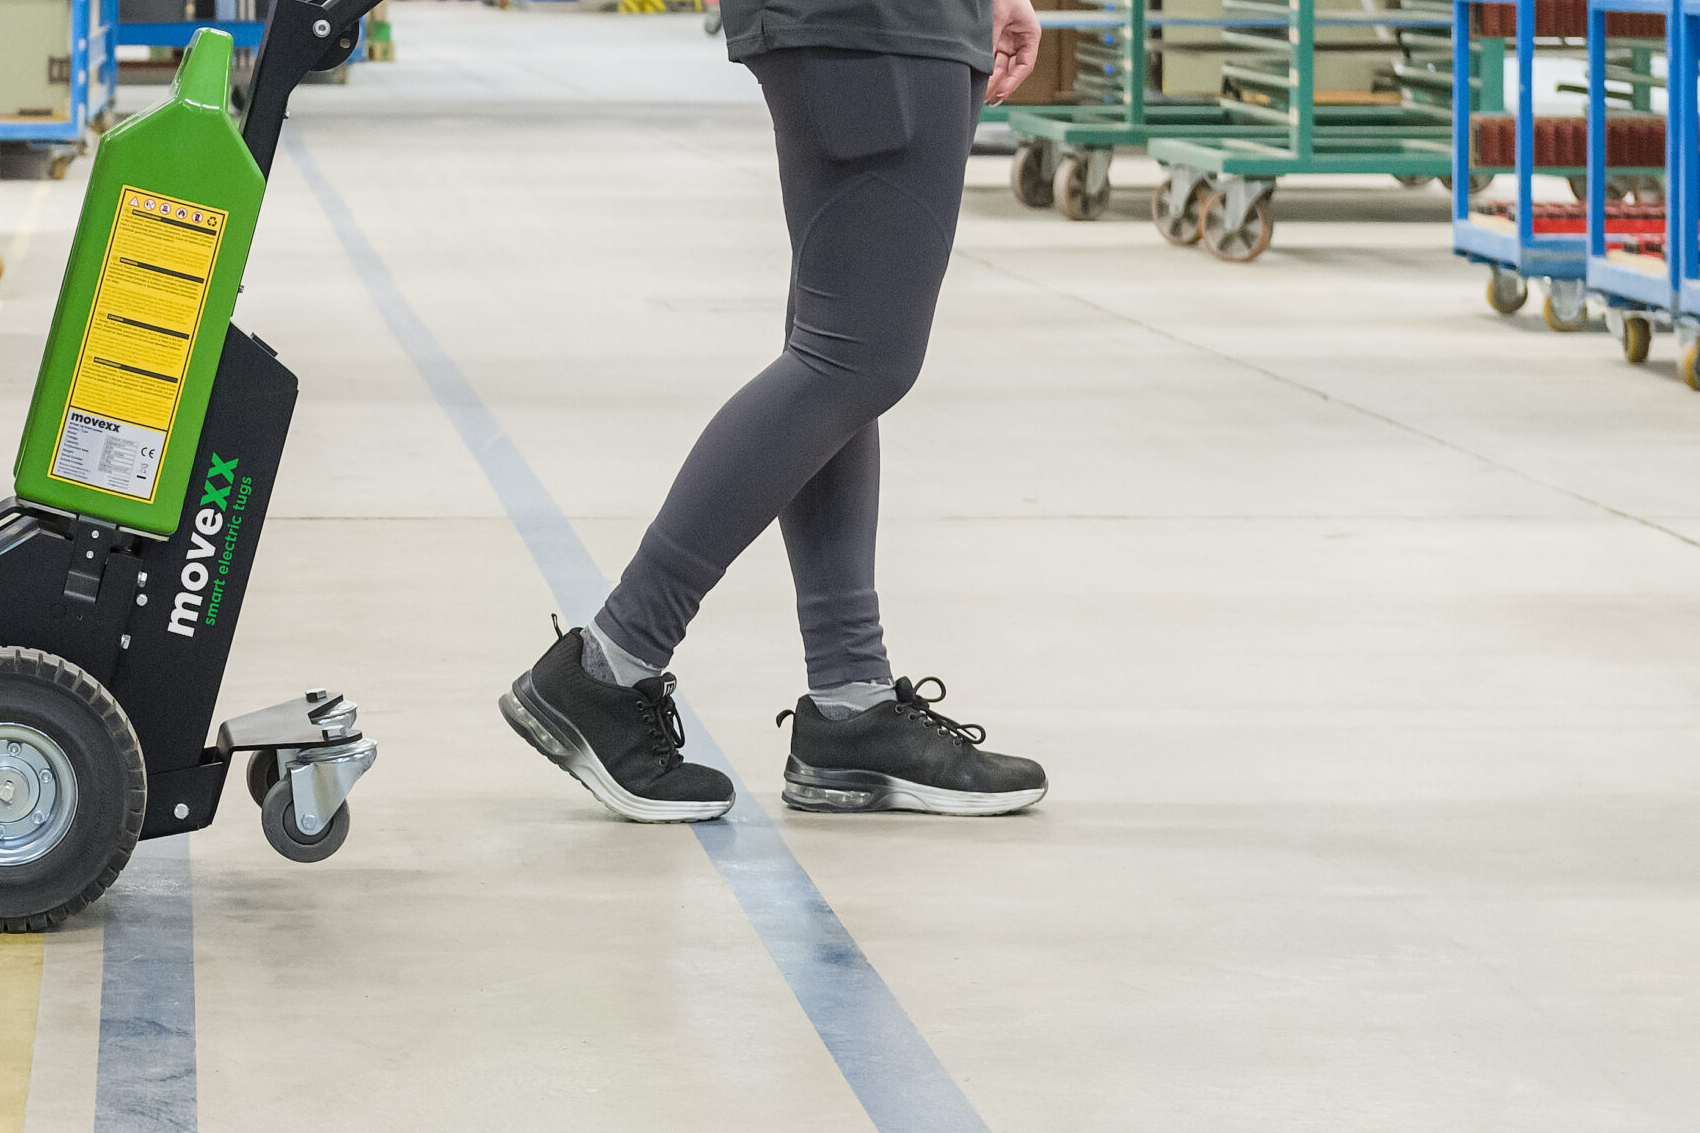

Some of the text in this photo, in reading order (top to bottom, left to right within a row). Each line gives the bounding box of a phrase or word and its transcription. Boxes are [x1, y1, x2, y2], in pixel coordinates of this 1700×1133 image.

[71, 412, 121, 433] movexx
[167, 451, 239, 638] movexx
[205, 475, 252, 626] smart electric tugs
